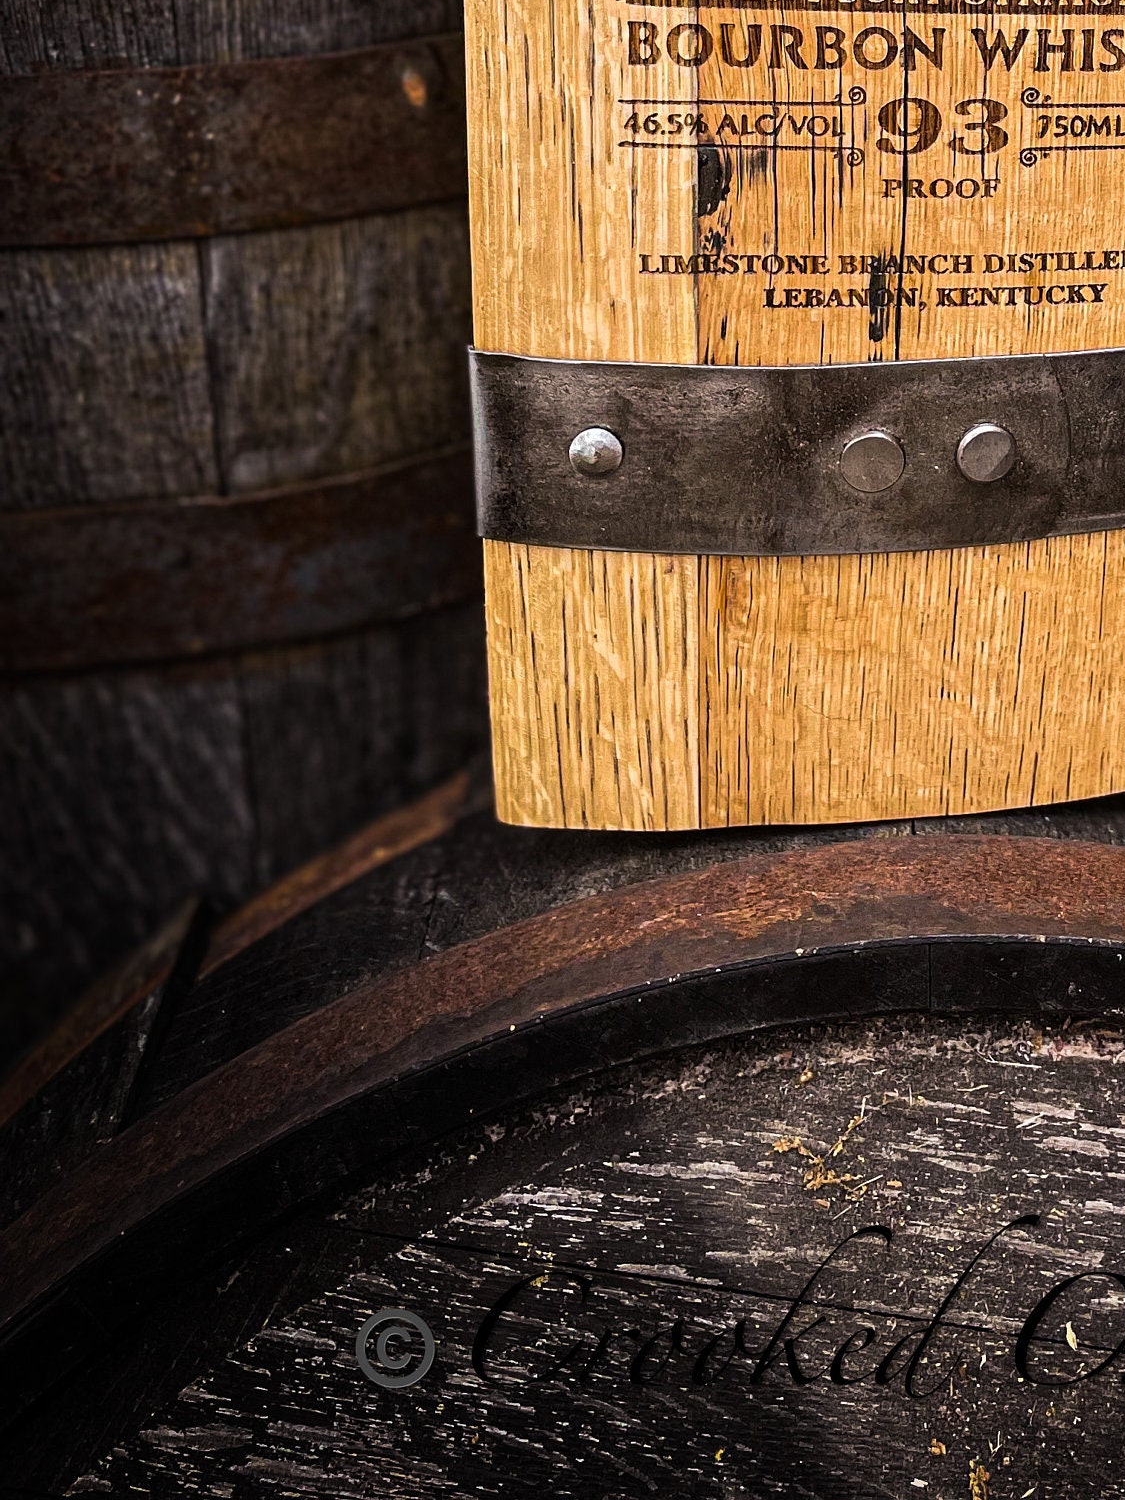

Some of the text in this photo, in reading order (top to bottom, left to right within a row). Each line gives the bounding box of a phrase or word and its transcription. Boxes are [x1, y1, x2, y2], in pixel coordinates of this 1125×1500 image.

[627, 20, 946, 72] BOURBON
[624, 107, 846, 138] 46.5% ALC/VOL
[876, 97, 1009, 156] 93
[881, 177, 1001, 200] PROOF
[638, 252, 831, 276] LIMESTONE
[839, 252, 975, 276] BRANCH
[762, 282, 1108, 311] LEBANON, KENTUCKY
